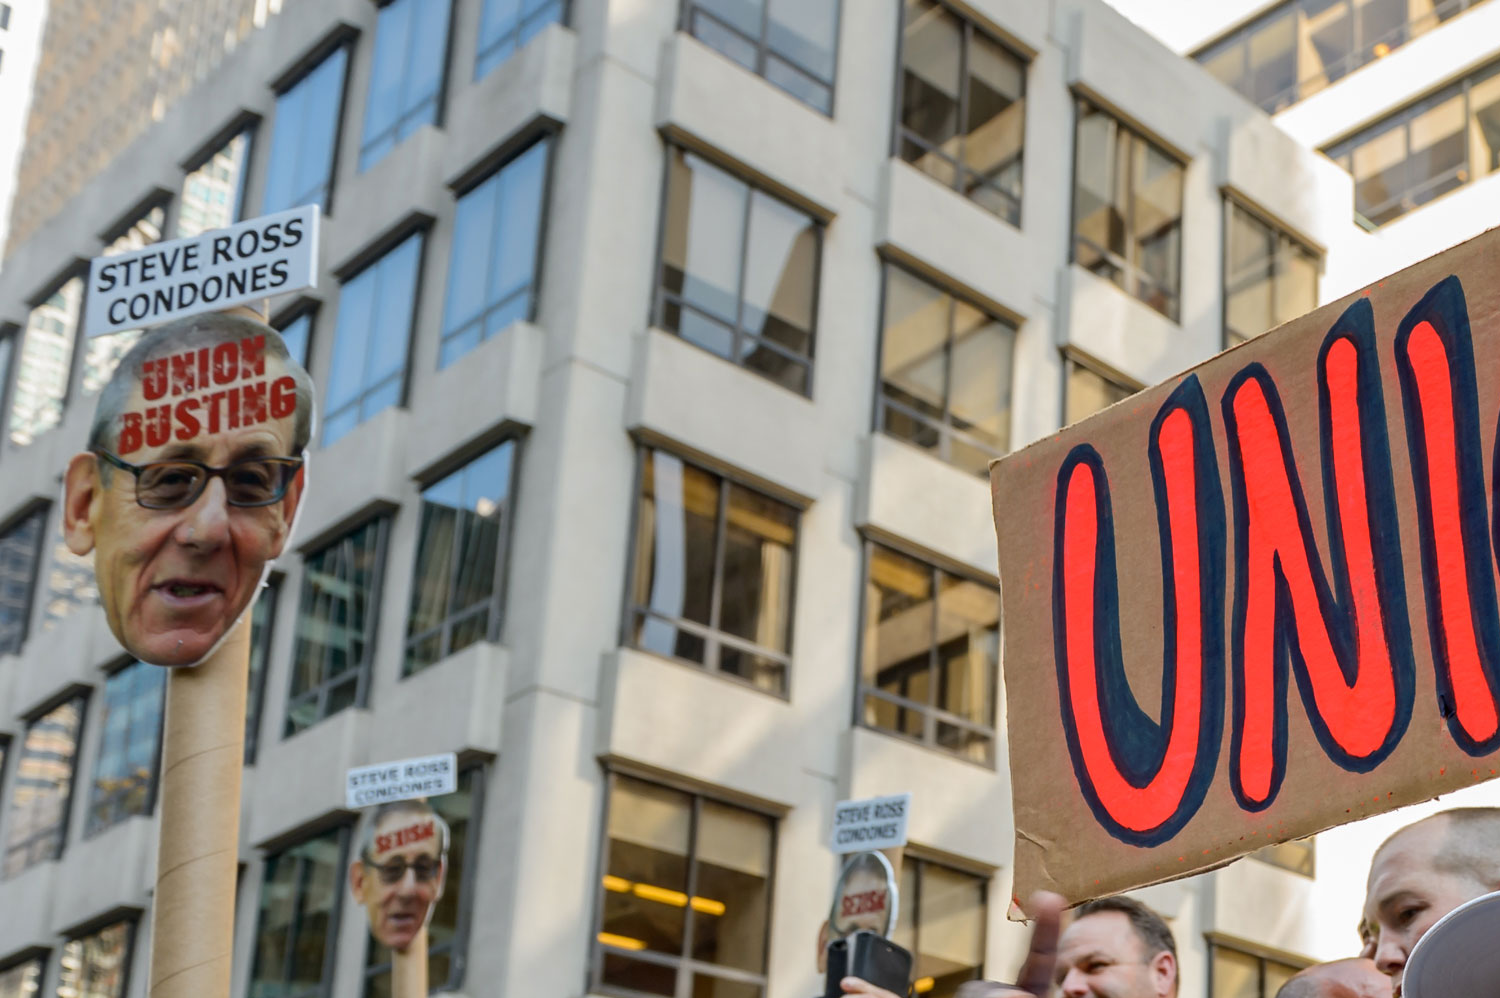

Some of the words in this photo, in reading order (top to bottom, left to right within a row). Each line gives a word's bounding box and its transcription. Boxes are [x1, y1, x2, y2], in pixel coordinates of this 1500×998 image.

[97, 243, 199, 293] STEVE
[211, 218, 303, 266] ROSS
[107, 259, 289, 325] CONDONES
[141, 334, 266, 401] UNION
[117, 375, 297, 456] BUSTING
[349, 768, 399, 788] STEVE
[404, 760, 450, 777] ROSS
[354, 778, 443, 805] CONDONES
[836, 804, 871, 825] STEVE
[874, 799, 905, 819] ROSS
[375, 820, 435, 855] SEXISM
[836, 822, 898, 845] CONDONES
[842, 888, 886, 917] SEXISM
